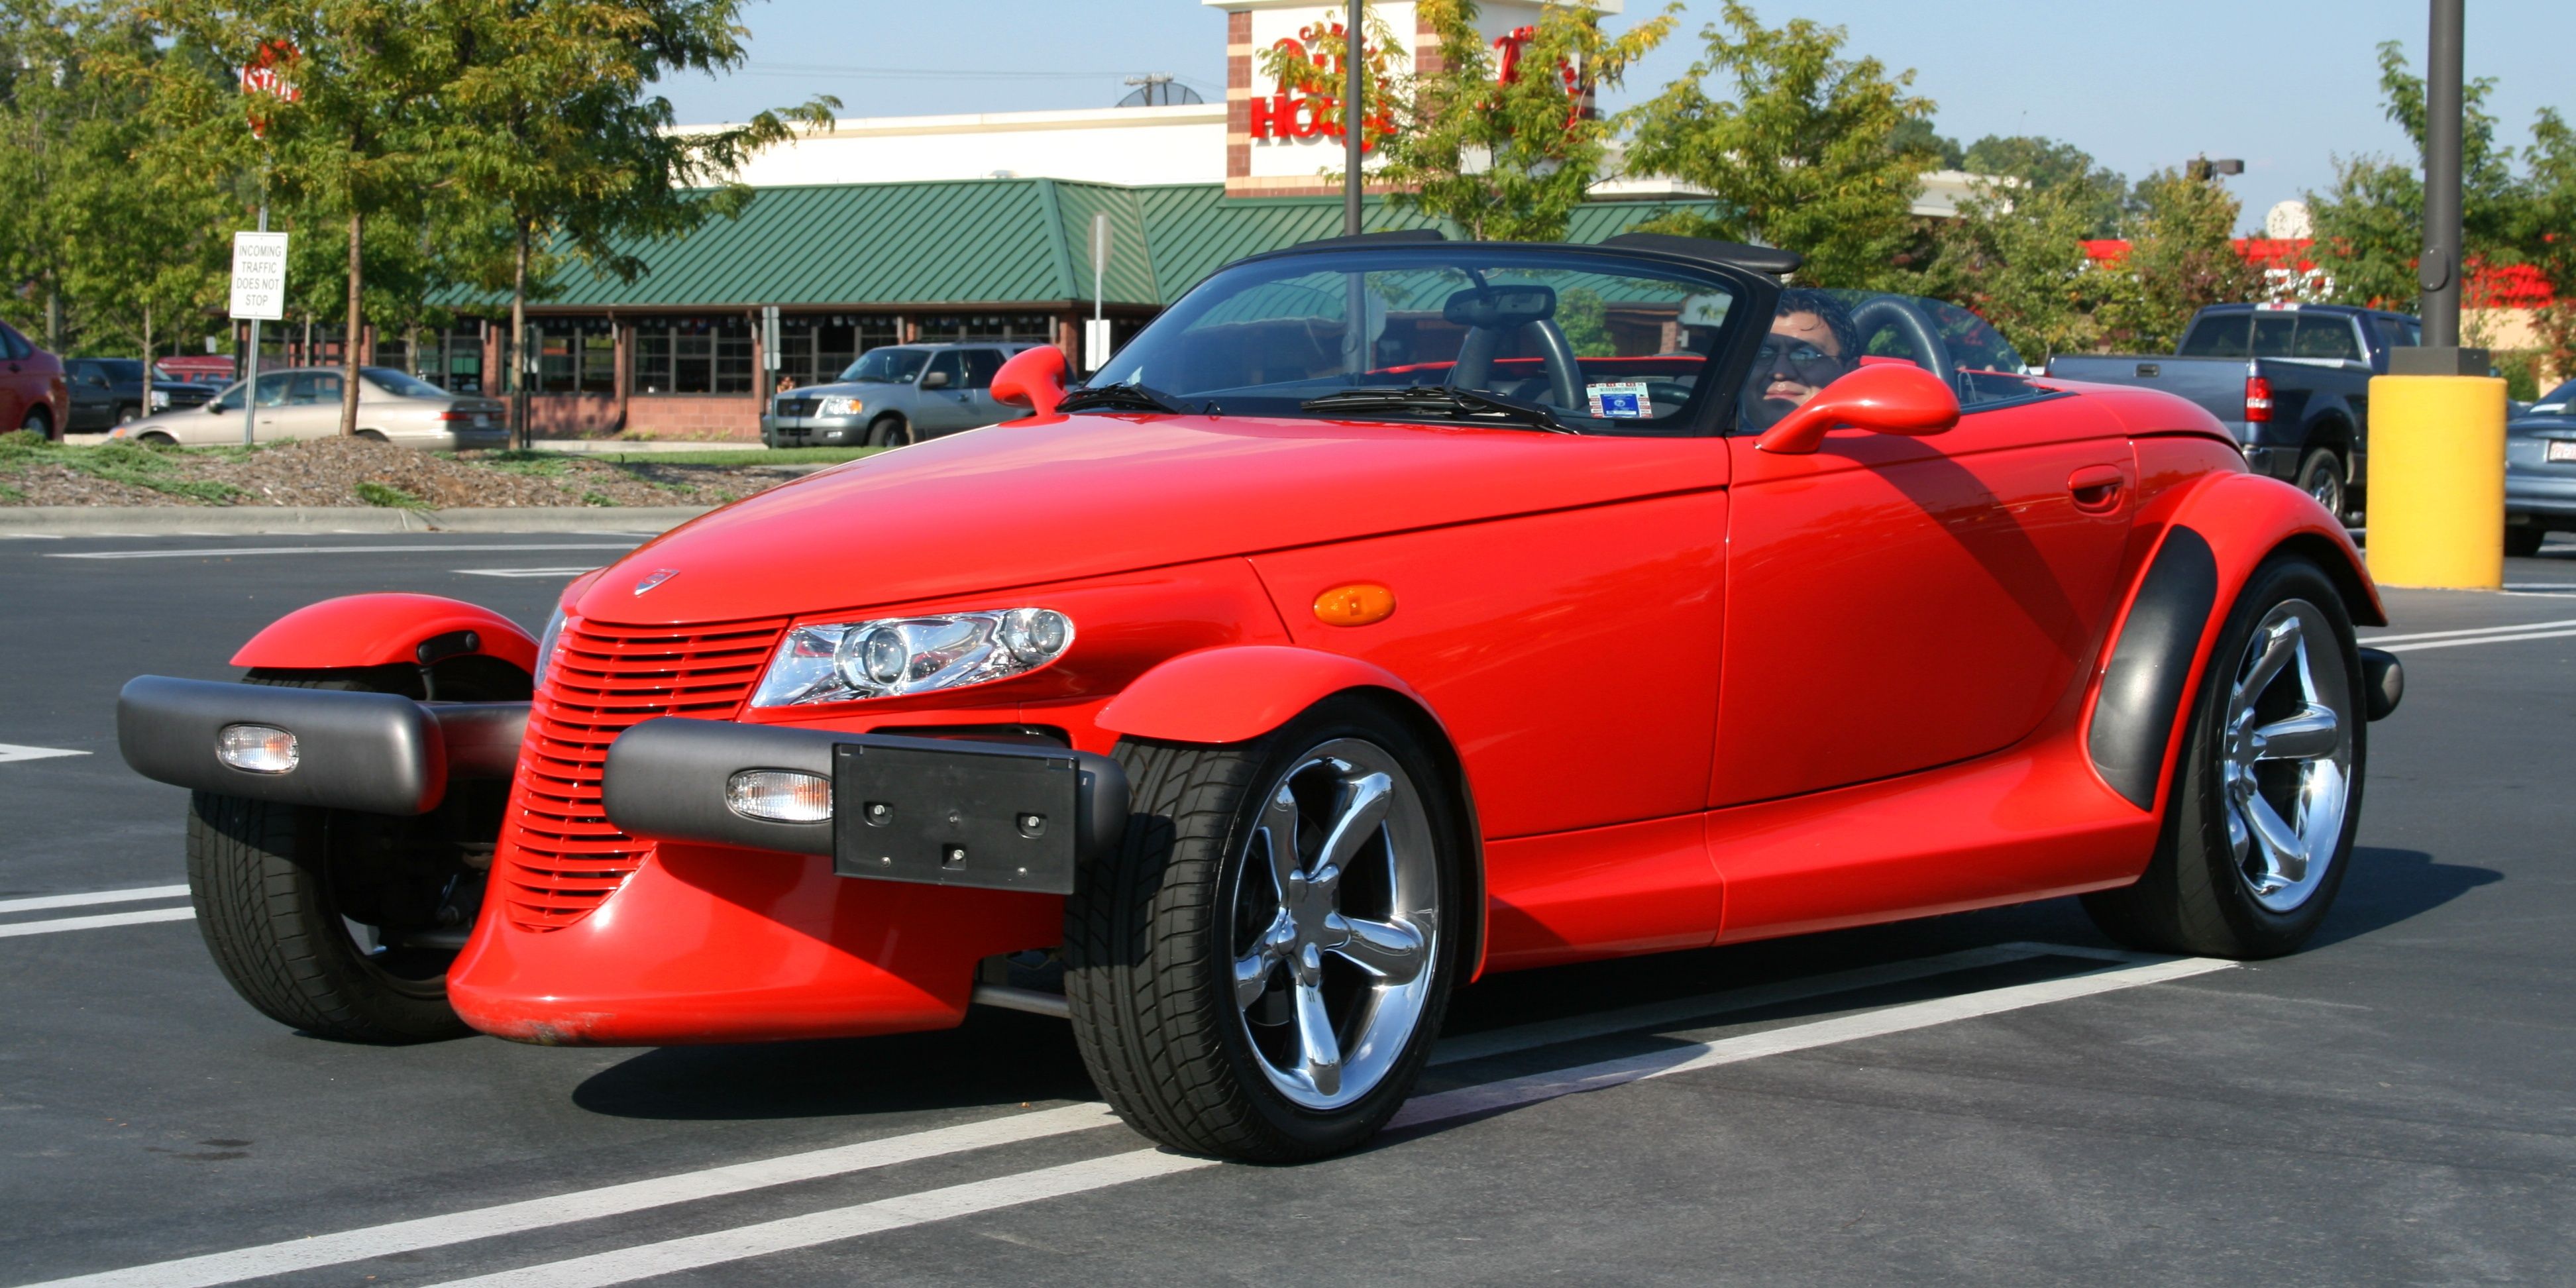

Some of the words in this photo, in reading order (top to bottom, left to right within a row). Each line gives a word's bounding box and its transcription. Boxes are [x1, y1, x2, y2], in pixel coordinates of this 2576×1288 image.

[240, 245, 282, 257] INCOMING
[242, 262, 277, 273] TRAFFIC
[237, 278, 260, 290] DOES
[262, 278, 280, 290] NOT
[246, 294, 268, 306] STOP
